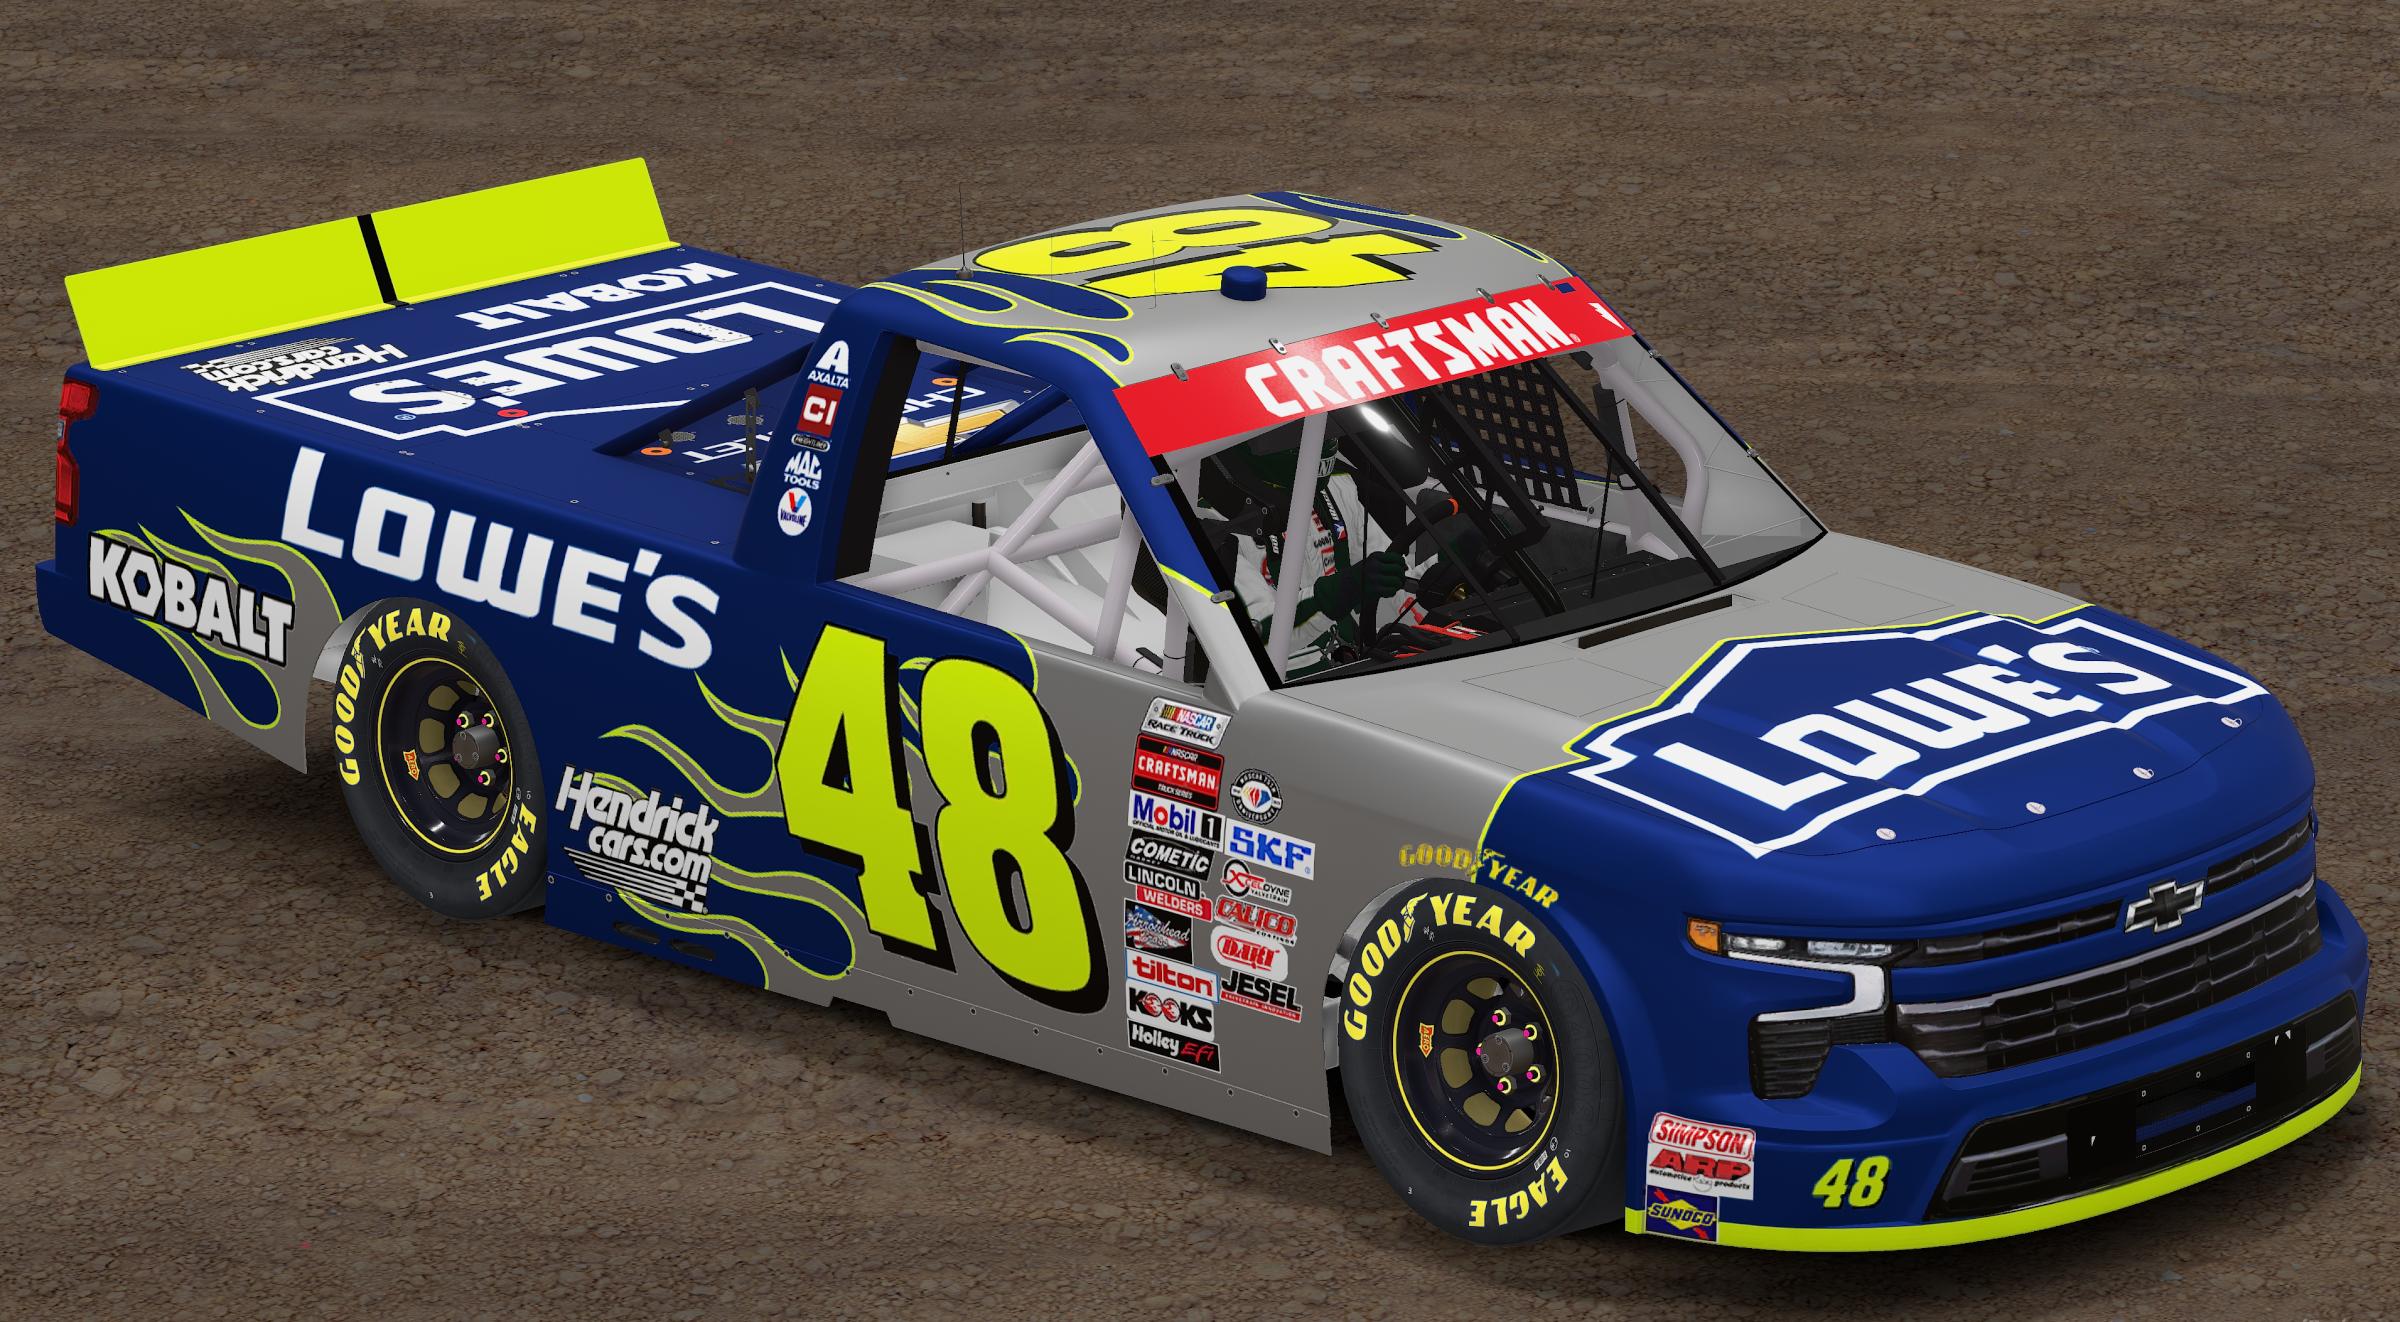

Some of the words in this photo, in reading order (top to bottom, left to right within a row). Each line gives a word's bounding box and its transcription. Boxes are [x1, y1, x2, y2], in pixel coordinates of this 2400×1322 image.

[974, 208, 1435, 299] 48
[456, 262, 739, 331] KOBALT
[217, 343, 409, 392] Hendrick
[1244, 299, 1574, 417] CRAFTSMAN
[807, 370, 850, 389] AXALTA
[803, 396, 837, 426] CI
[784, 473, 820, 490] TOOLS
[785, 451, 822, 481] MAC
[281, 446, 721, 668] LOWE'S
[89, 534, 293, 665] KOBALT
[1148, 719, 1178, 733] RACE
[1180, 726, 1215, 744] TRUCK
[1176, 708, 1215, 731] NASCAR
[1654, 642, 2173, 811] LOWE'S
[1138, 756, 1216, 790] CRAFTSMAN
[1171, 747, 1199, 762] NASCAR
[555, 765, 719, 853] Hendrick
[776, 622, 1098, 998] 48
[1158, 784, 1174, 795] TRUCK
[1174, 789, 1193, 800] SERIES
[1133, 794, 1196, 834] Mobil
[475, 802, 537, 901] EAGLE
[588, 826, 712, 884] cars.com
[1131, 838, 1210, 872] COMETIC
[1231, 826, 1312, 870] SKF
[1128, 865, 1196, 899] LINCOLN
[1251, 889, 1288, 903] VALVETRAIN
[1143, 888, 1203, 917] WELDERS
[1216, 898, 1297, 938] CALICO
[1125, 912, 1190, 942] Arrowhead
[1133, 956, 1213, 997] tilton
[1221, 971, 1301, 1012] JESEL
[1130, 987, 1212, 1033] KOOKS
[1132, 1024, 1180, 1057] Holley
[1422, 1026, 1432, 1051] AERO
[1656, 1120, 1747, 1154] SIMPSON
[1650, 1149, 1750, 1181] ARP
[1812, 1155, 1891, 1209] 48
[1468, 1156, 1568, 1228] EAGLE
[1651, 1204, 1713, 1224] SUNOCO
